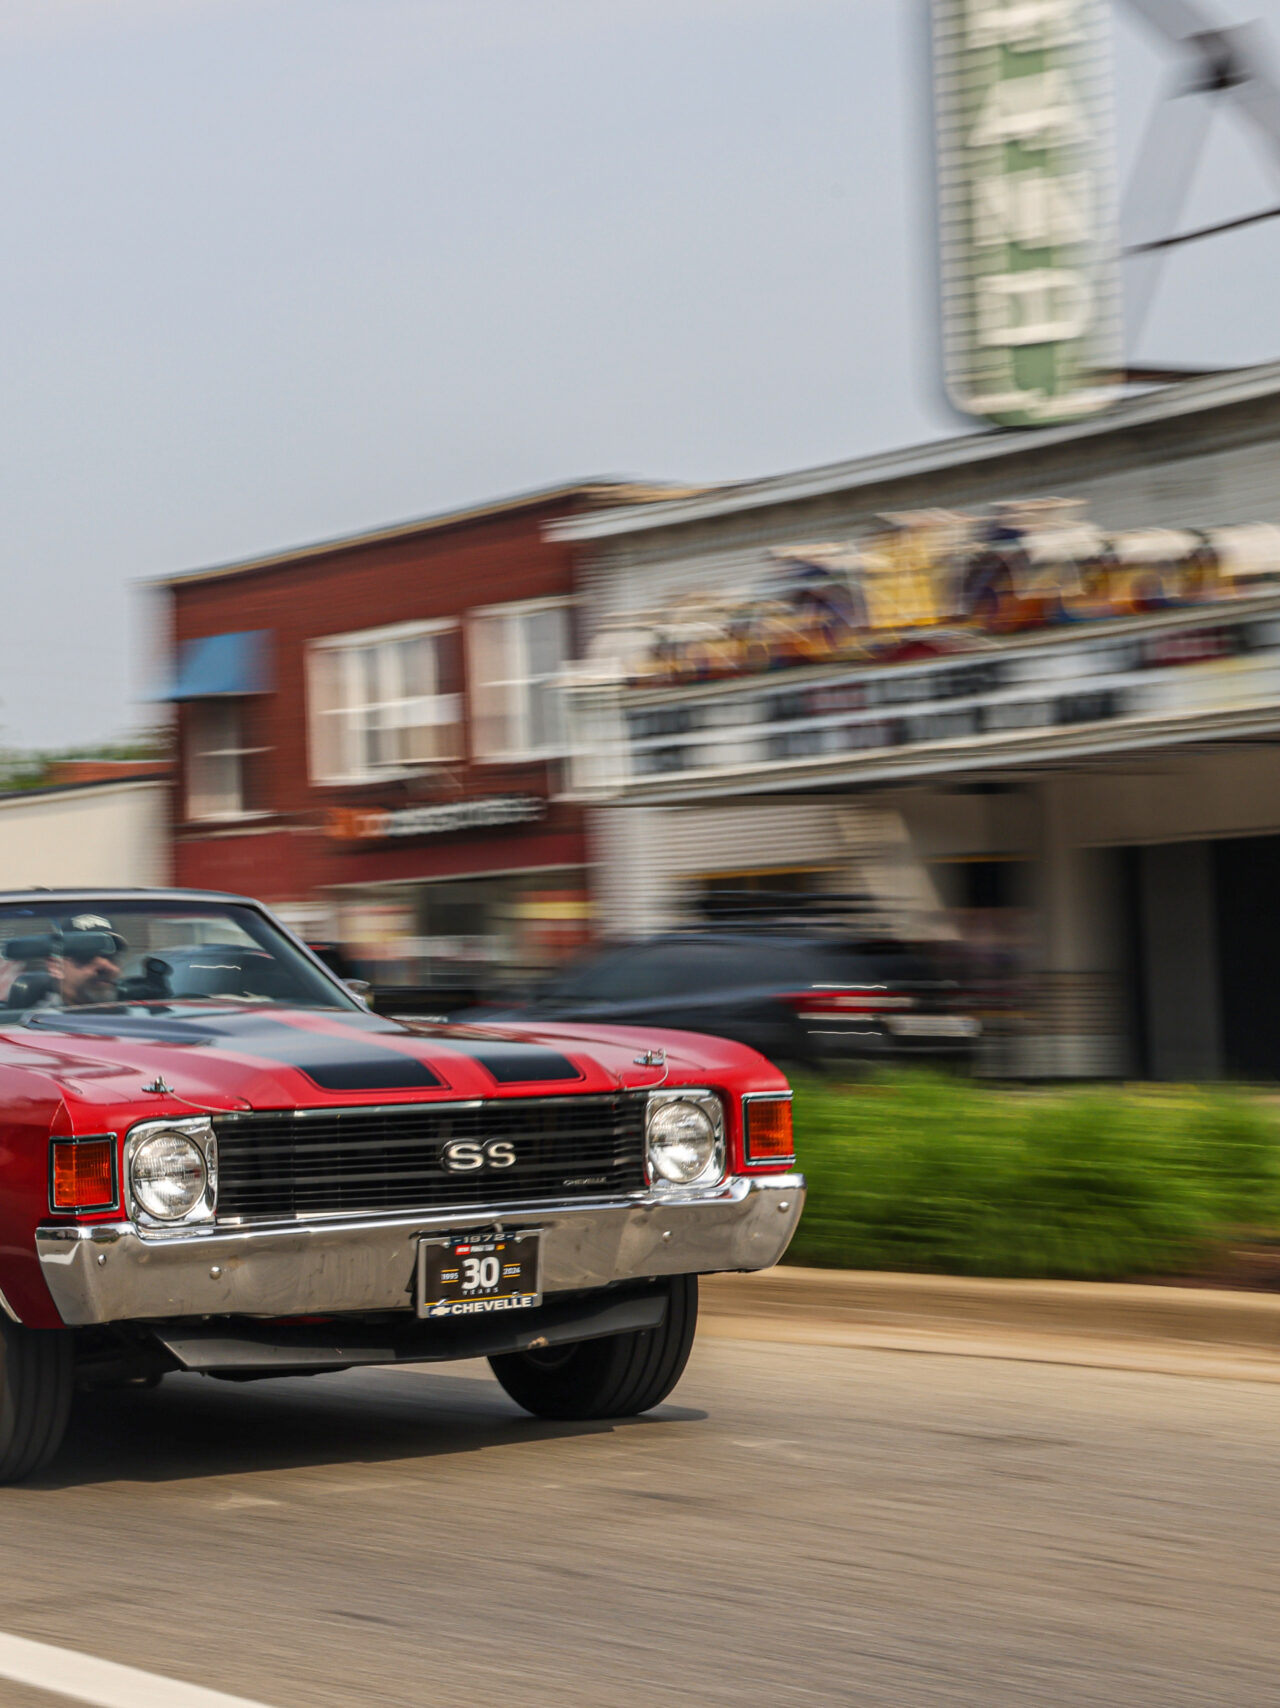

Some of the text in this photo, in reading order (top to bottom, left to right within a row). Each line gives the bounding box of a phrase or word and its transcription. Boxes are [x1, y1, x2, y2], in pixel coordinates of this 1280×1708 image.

[447, 1141, 517, 1170] SS
[461, 1256, 500, 1290] 30
[462, 1287, 499, 1296] YEARS
[451, 1297, 532, 1315] CHEVELLE
